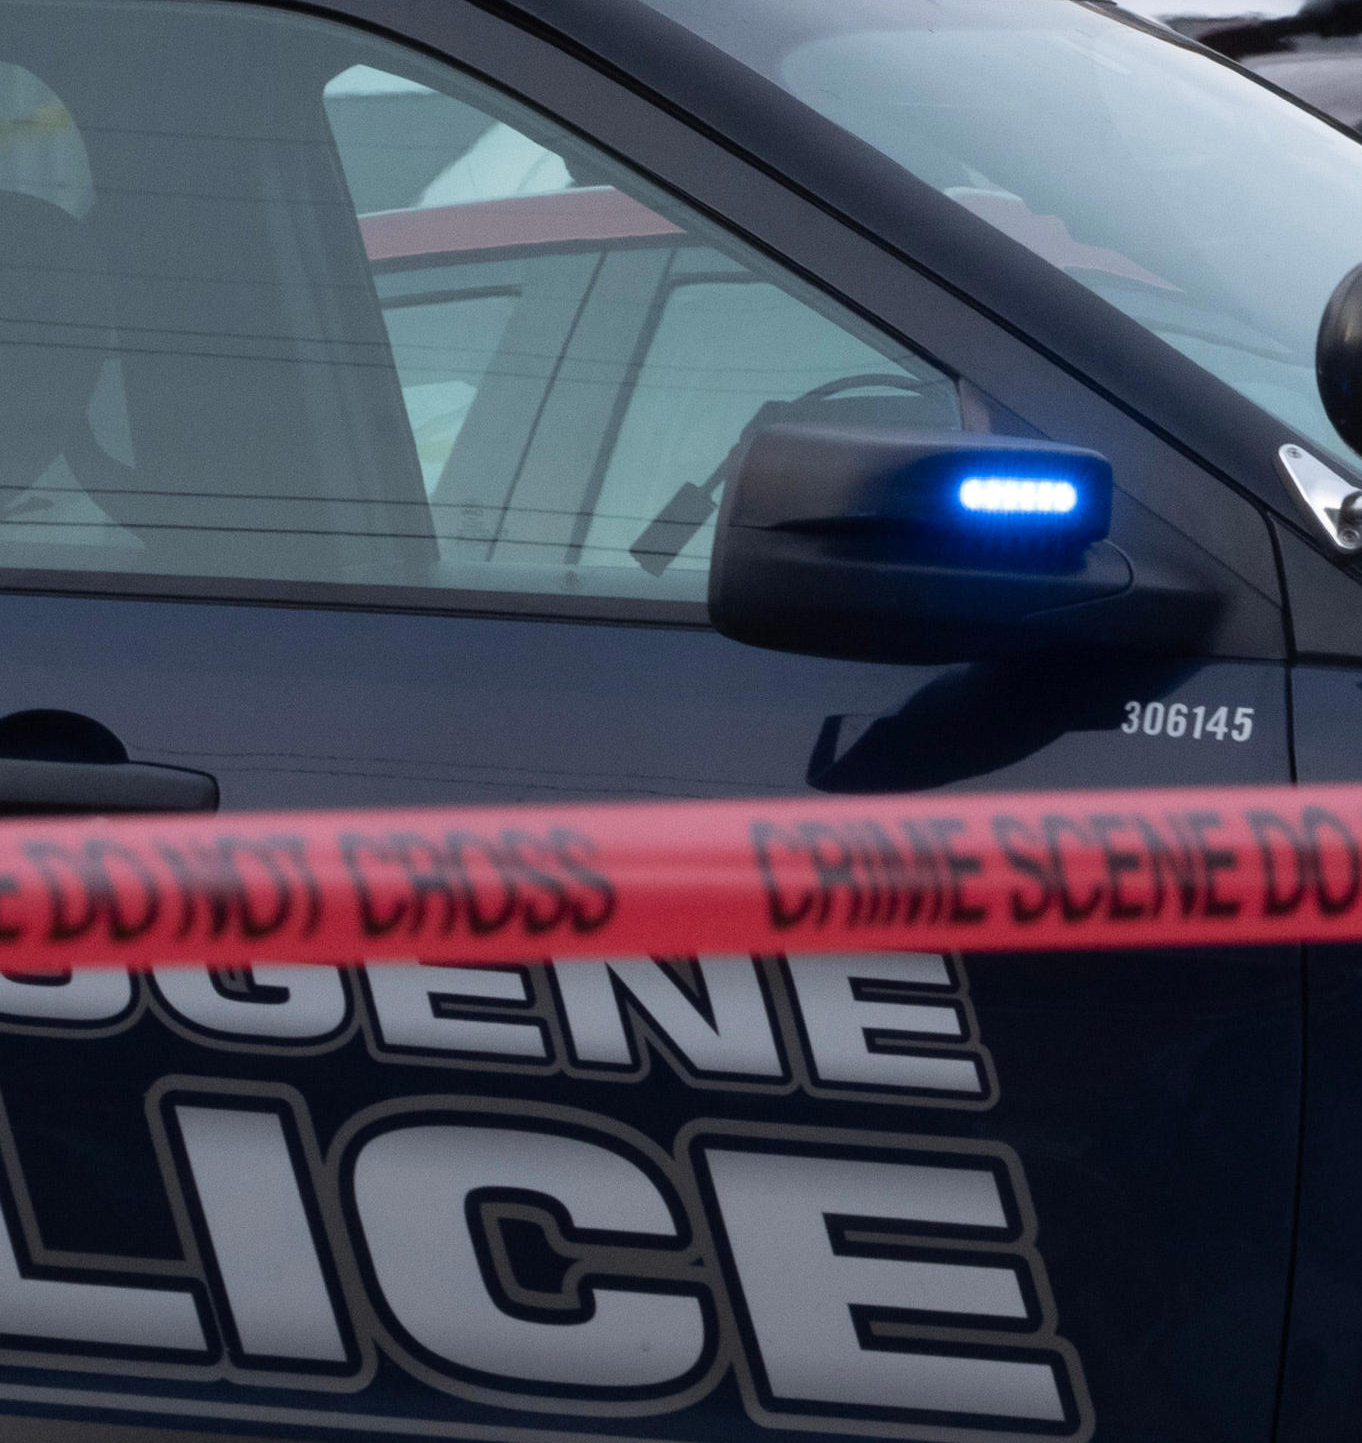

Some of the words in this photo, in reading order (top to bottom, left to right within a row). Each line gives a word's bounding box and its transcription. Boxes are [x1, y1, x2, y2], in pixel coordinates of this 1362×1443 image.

[1121, 700, 1255, 742] 306145
[22, 835, 162, 943] DO
[336, 825, 618, 938] CROSS
[749, 817, 987, 930] CRIME
[990, 809, 1240, 924] SCENE
